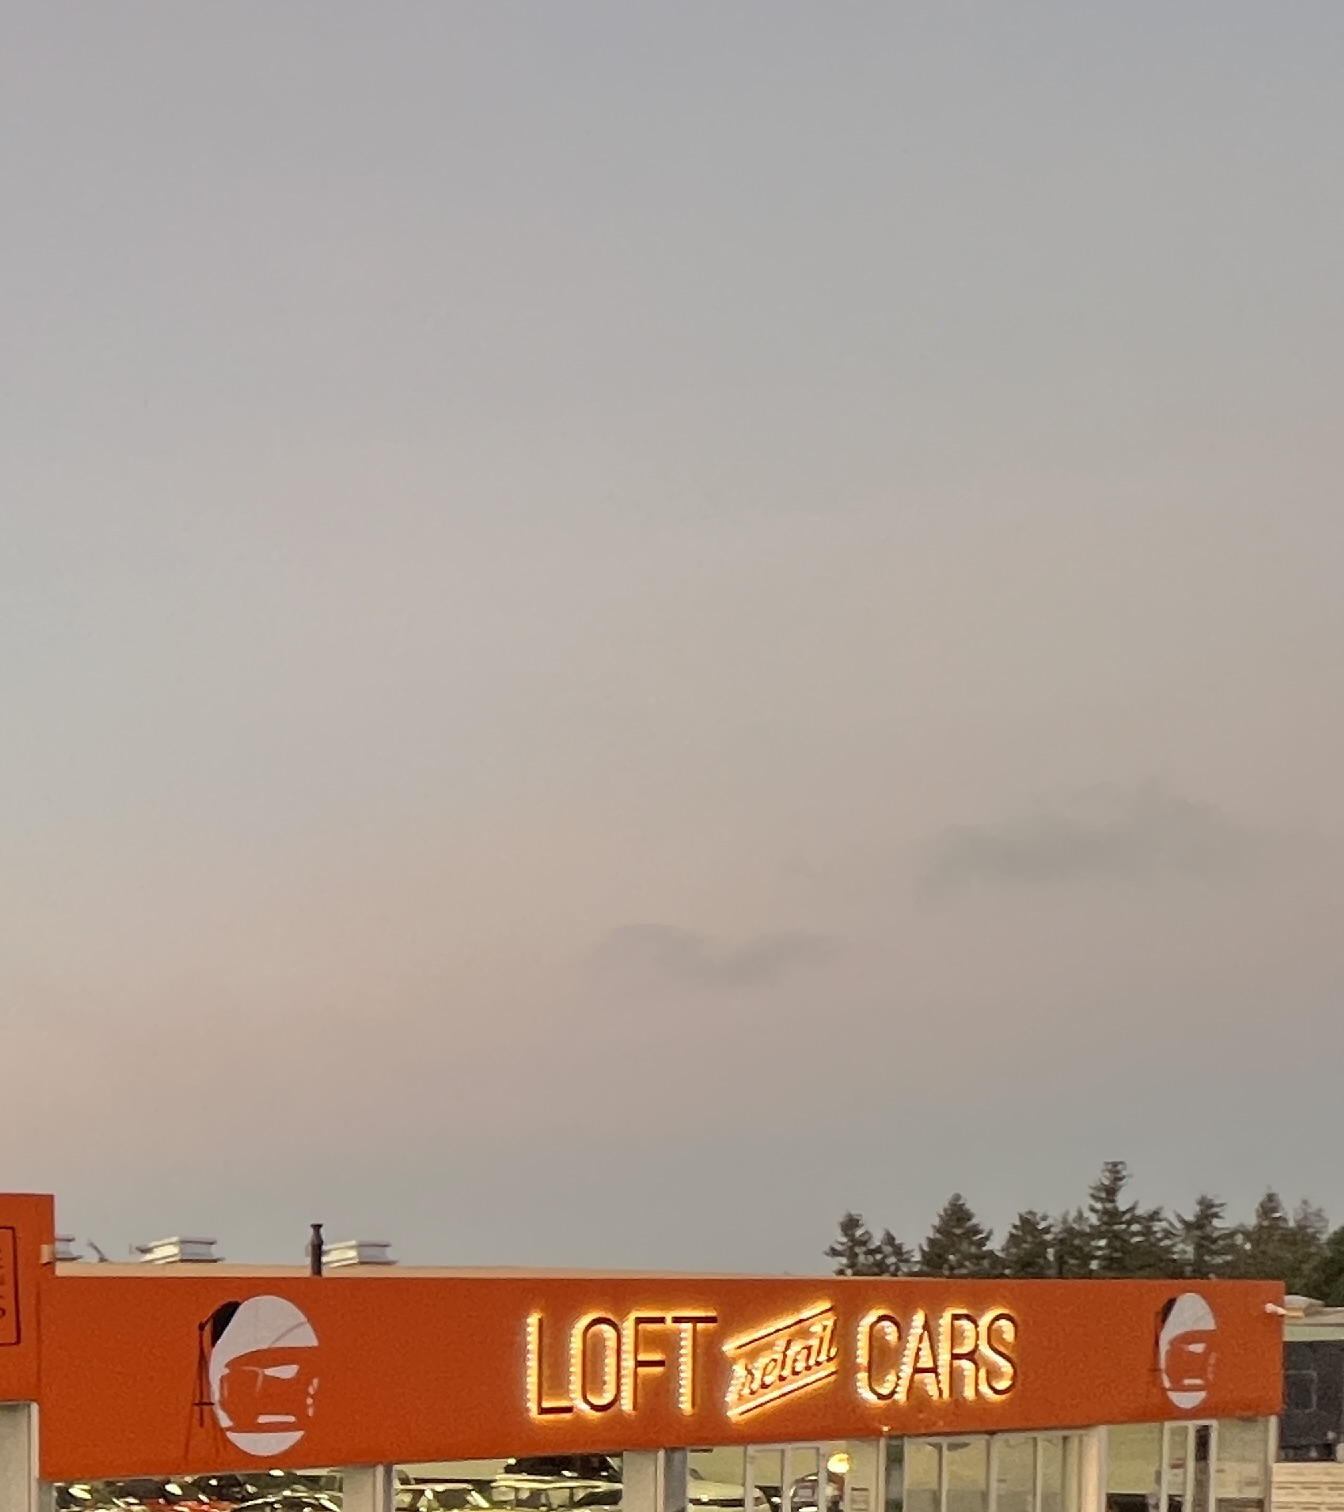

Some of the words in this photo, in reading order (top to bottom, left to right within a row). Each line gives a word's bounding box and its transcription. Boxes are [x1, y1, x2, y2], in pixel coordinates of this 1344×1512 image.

[526, 1312, 718, 1415] LOFT
[726, 1316, 839, 1402] retail
[857, 1309, 1017, 1402] CARS
